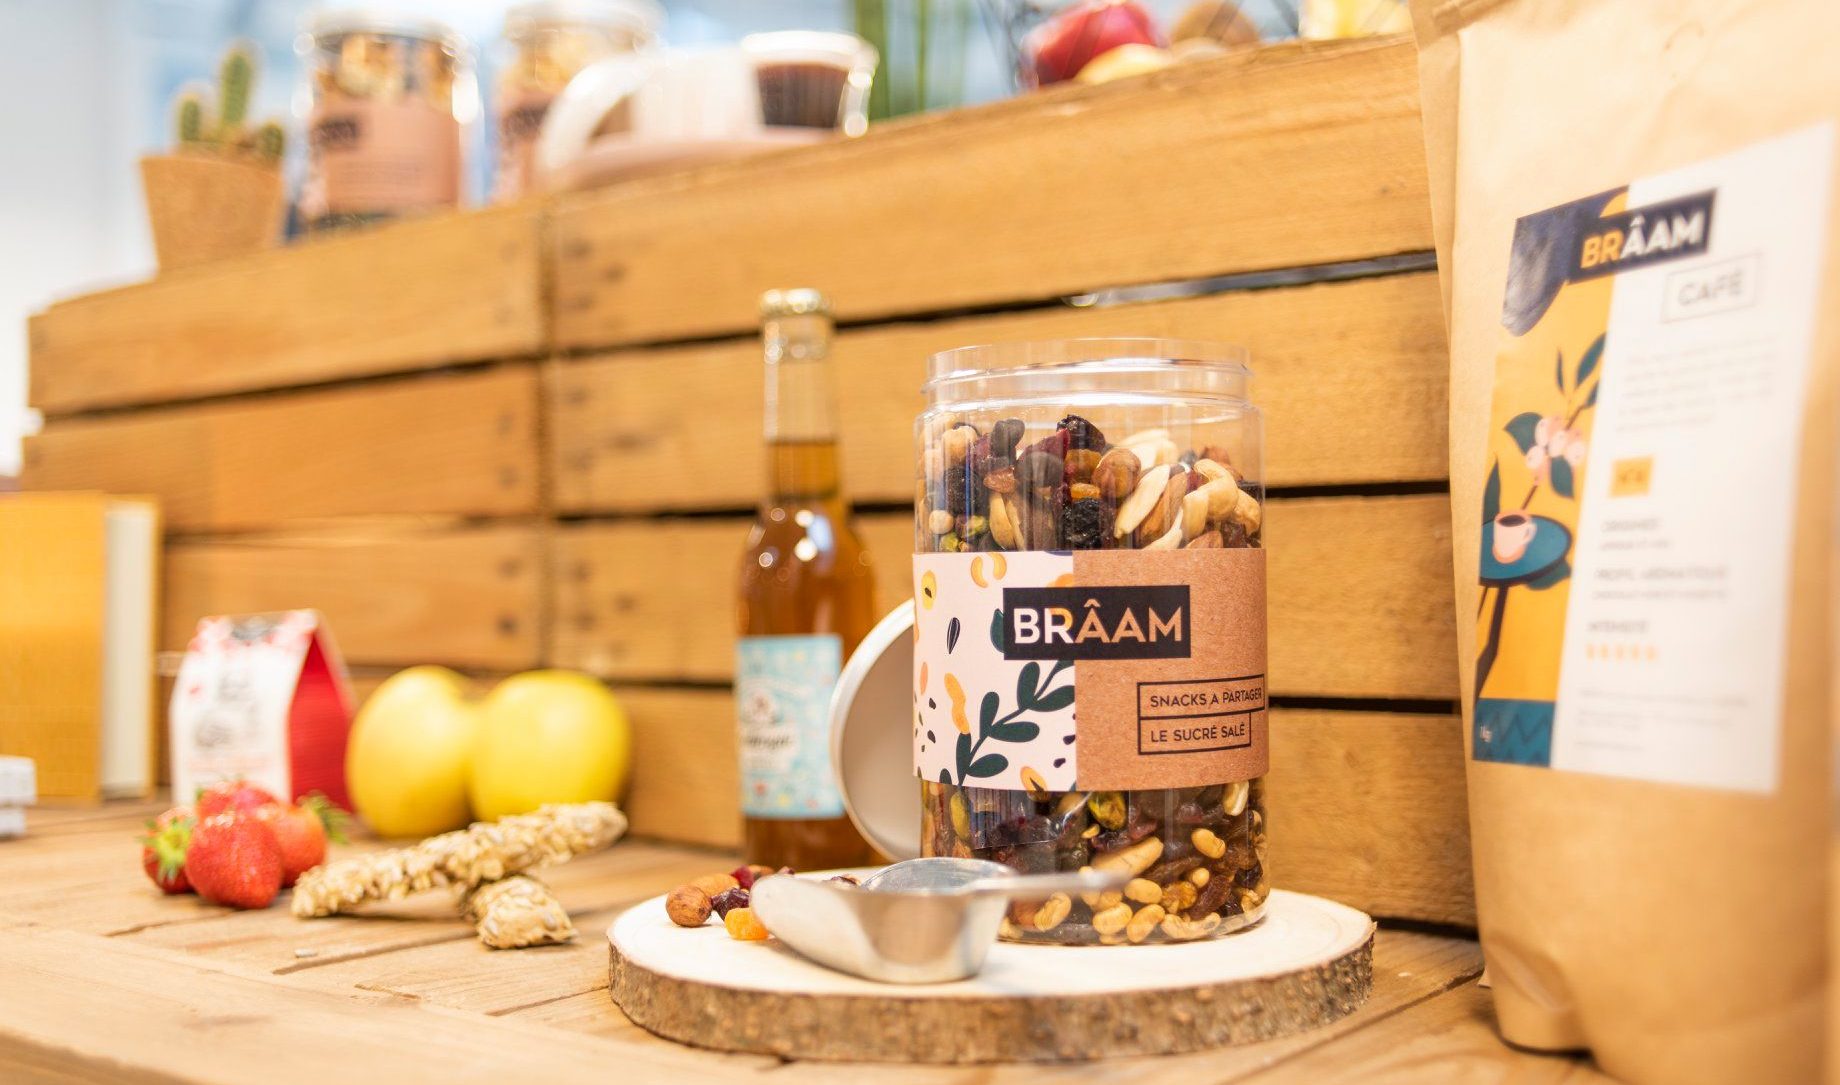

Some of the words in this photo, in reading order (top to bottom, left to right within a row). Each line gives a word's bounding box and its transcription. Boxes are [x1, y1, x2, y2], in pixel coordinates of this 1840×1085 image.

[1580, 209, 1707, 269] BRÂAM
[1012, 598, 1183, 645] BRÂAM
[1150, 693, 1208, 708] SNACKS
[1222, 687, 1262, 703] PARTAGER
[1150, 730, 1168, 743] LE
[1173, 725, 1218, 741] SUCRÉ
[1221, 722, 1245, 738] SALÉ
